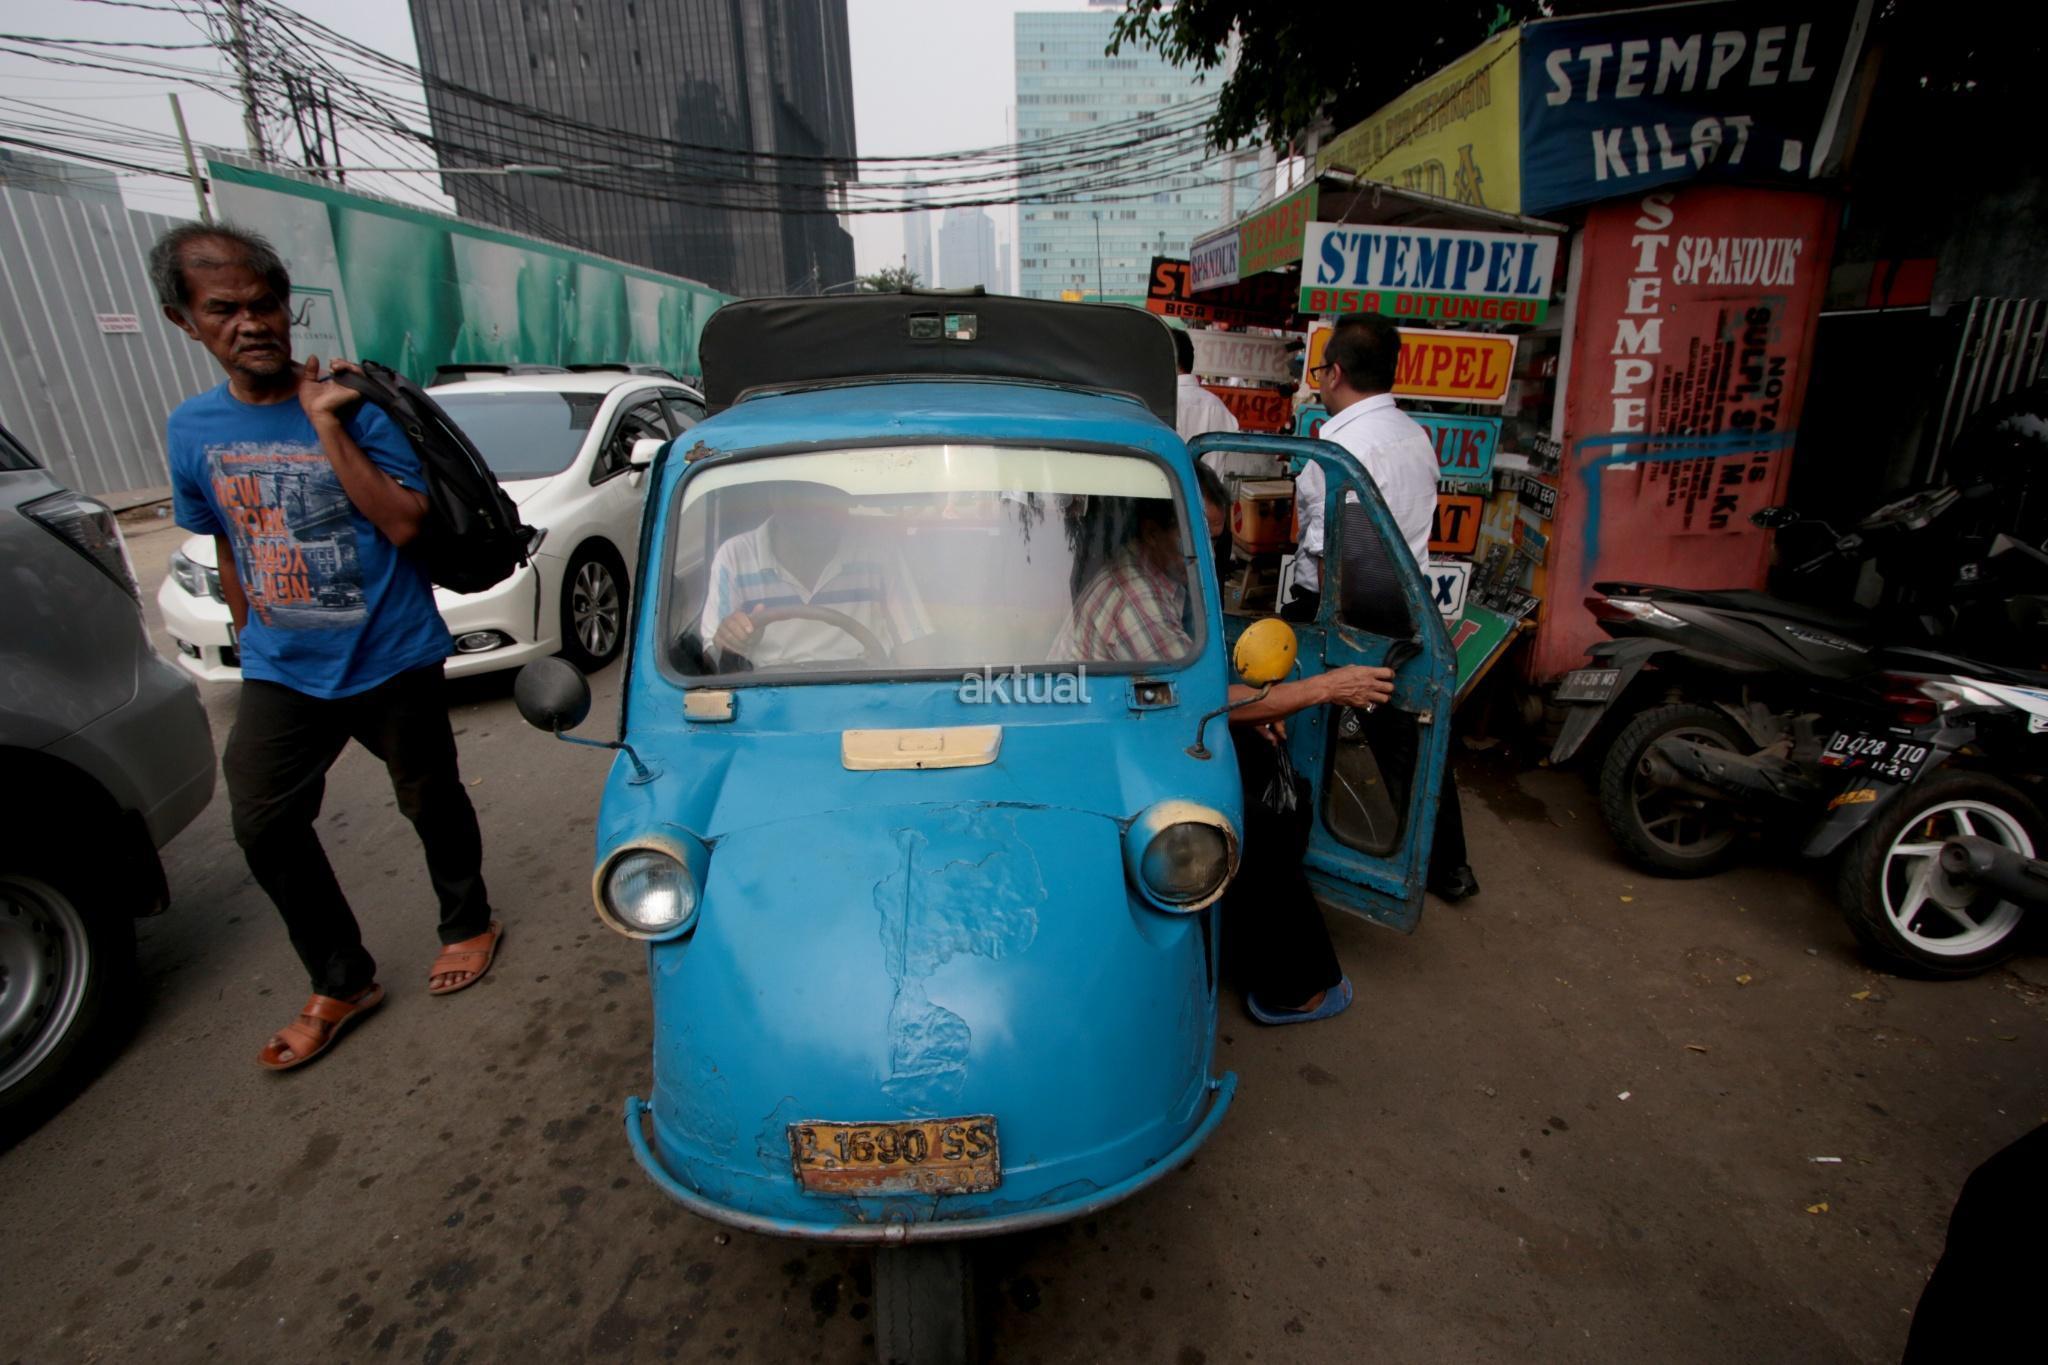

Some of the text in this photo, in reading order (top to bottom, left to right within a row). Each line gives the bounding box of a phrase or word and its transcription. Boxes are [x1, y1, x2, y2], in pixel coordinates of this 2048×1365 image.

[1546, 23, 1816, 106] STEMPEL
[1592, 115, 1754, 181] KILAT
[1192, 240, 1238, 284] SPANDUK
[1317, 231, 1541, 294] STEMPEL
[1673, 235, 1802, 286] SPANDUK
[1165, 302, 1205, 318] BISA
[1309, 290, 1537, 322] BISA DITUNGGU
[1394, 343, 1498, 389] MPEL
[1748, 357, 1786, 482] NOTAIS
[1833, 735, 1849, 751] B
[834, 1127, 928, 1164] 1690
[941, 1124, 991, 1160] SS
